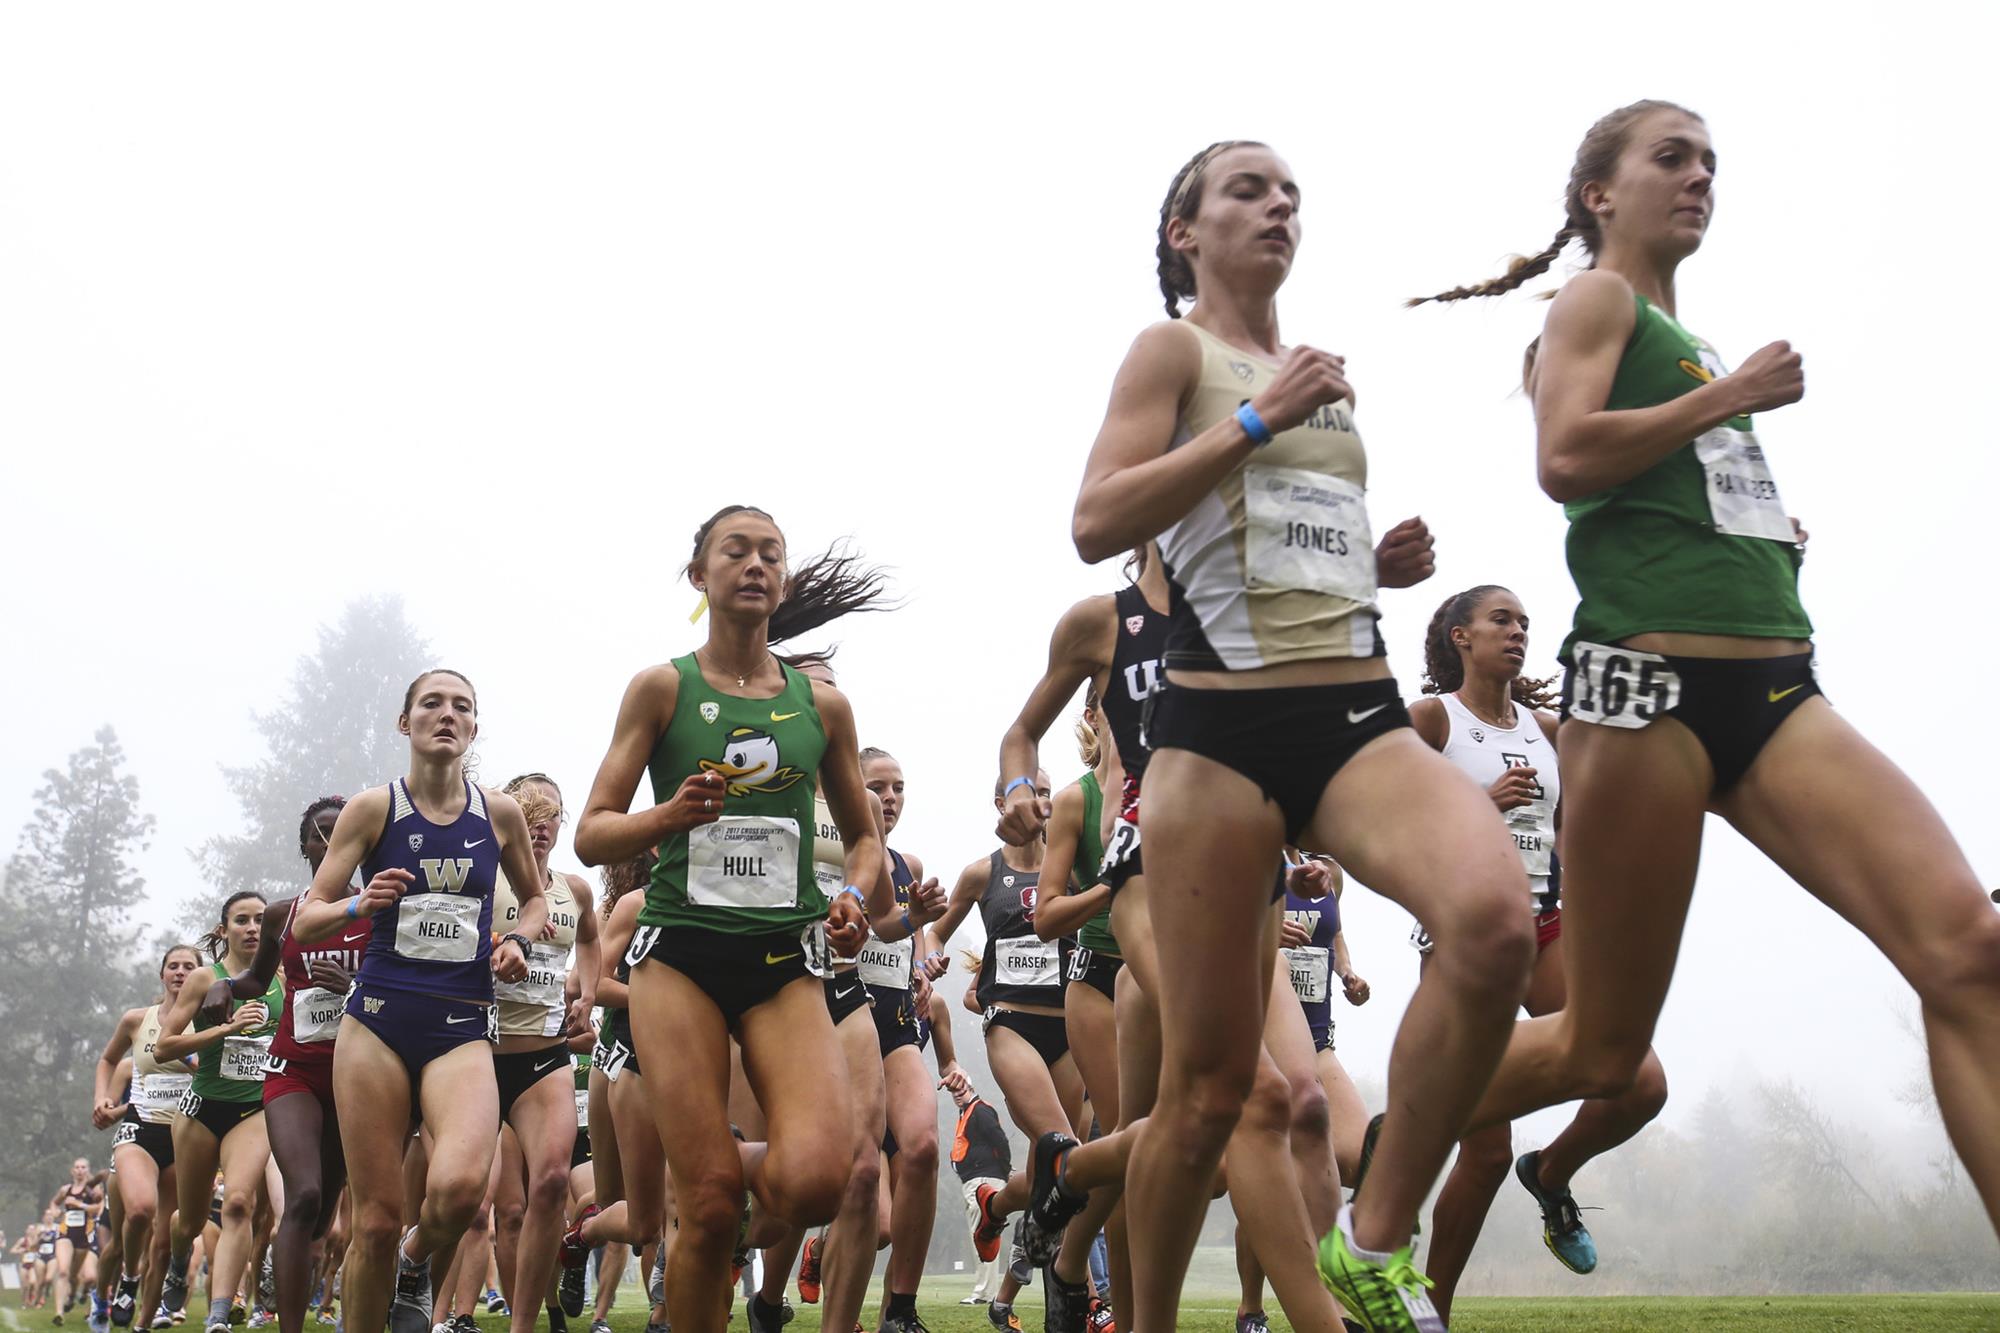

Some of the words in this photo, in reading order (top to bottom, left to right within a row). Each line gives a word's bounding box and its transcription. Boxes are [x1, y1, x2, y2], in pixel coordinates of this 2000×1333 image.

[1285, 521, 1349, 556] JONES
[1578, 649, 1669, 721] 165
[740, 827, 760, 836] CROSS
[760, 827, 785, 836] COUNTRY
[1512, 834, 1541, 852] REEN
[420, 858, 474, 892] W
[723, 856, 767, 877] HULL
[418, 921, 461, 939] NEALE
[860, 950, 902, 969] OAKLEY
[1008, 956, 1048, 969] FRASER
[361, 996, 386, 1015] W
[237, 1065, 261, 1076] BAEZ
[147, 1088, 187, 1100] SCHWART
